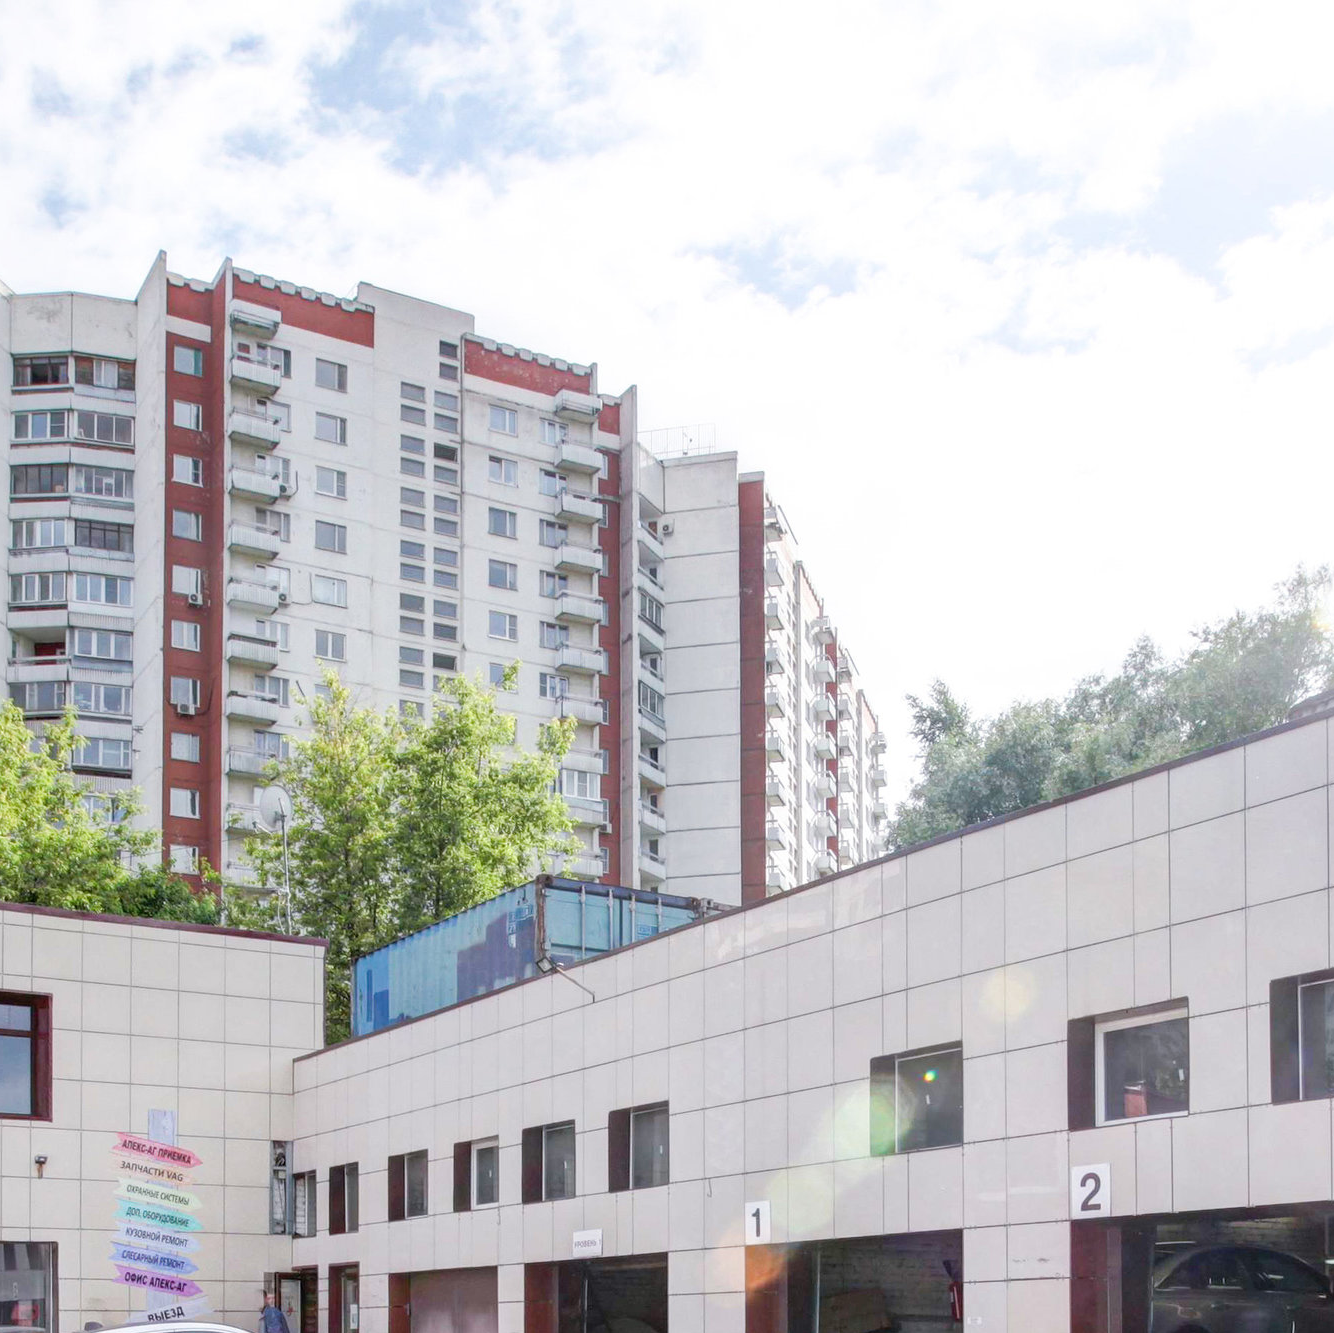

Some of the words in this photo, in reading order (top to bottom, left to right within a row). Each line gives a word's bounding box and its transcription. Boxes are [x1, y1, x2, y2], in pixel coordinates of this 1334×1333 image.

[157, 1148, 192, 1164] ПРИЕМКА
[120, 1160, 164, 1177] ЗАПЧАСТИ
[166, 1171, 184, 1182] VAG
[127, 1184, 159, 1200] ОХРАННЫЕ
[160, 1192, 190, 1206] СИСТЕМЫ
[1080, 1172, 1102, 1212] 2
[142, 1210, 190, 1227] ОБОРУДОВАНИЕ
[751, 1207, 761, 1237] 1
[126, 1227, 160, 1241] КУЗОВНОЙ
[161, 1235, 189, 1248] РЕМОНТ
[121, 1250, 158, 1264] СЛЕСАРНЫЙ
[159, 1257, 185, 1270] РЕМОНТ
[124, 1272, 148, 1285] ОФИС
[147, 1306, 185, 1322] ВЫЕЗД
